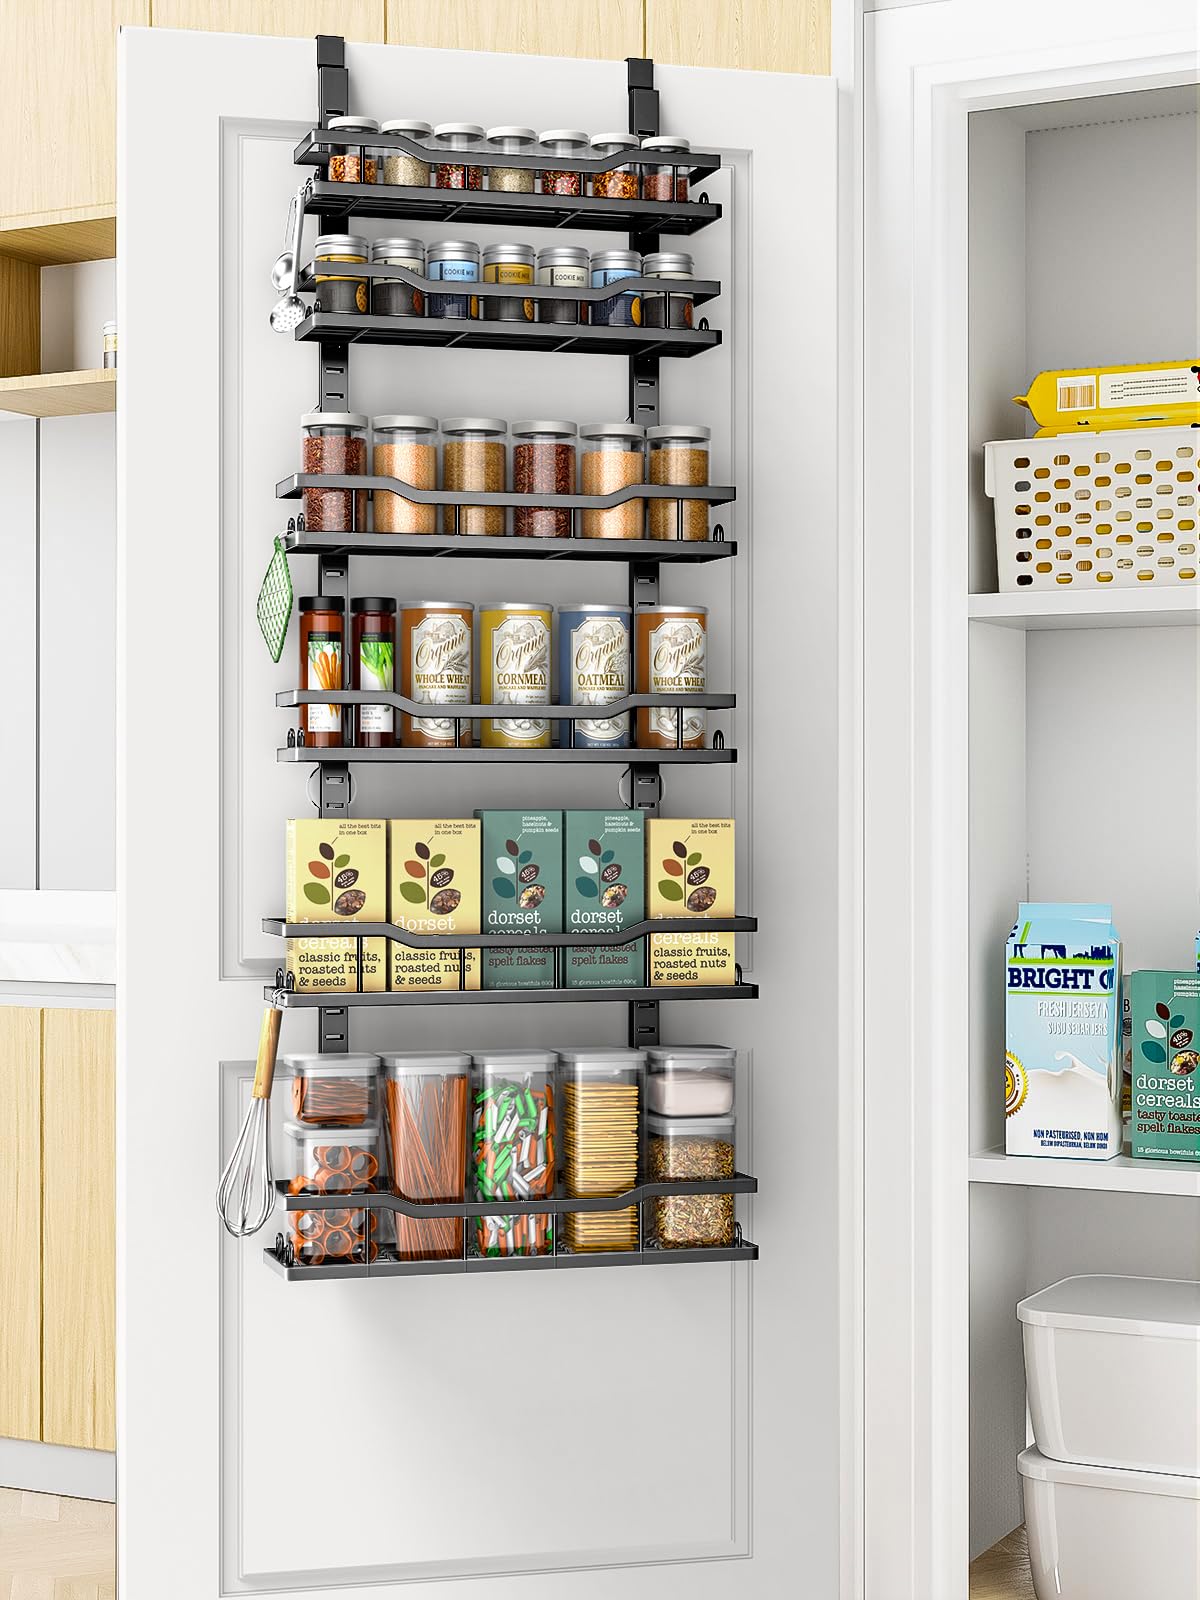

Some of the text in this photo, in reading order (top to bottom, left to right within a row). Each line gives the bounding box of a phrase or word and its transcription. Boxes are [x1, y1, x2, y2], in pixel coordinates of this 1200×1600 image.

[444, 268, 465, 276] COOKIE
[415, 628, 466, 673] Organic
[496, 630, 545, 672] Organic
[576, 631, 624, 672] Organic
[654, 632, 702, 673] Organic
[415, 674, 470, 684] WHOLE WHEAT
[497, 673, 547, 685] CORNMEAL
[578, 673, 624, 686] OATMEAL
[653, 676, 682, 687] WHOLE
[488, 910, 541, 925] dorset
[571, 909, 624, 924] dorset
[394, 916, 456, 931] dorset
[653, 933, 719, 945] cereals
[600, 943, 637, 952] toasted
[653, 947, 731, 958] classic fruits,
[298, 952, 340, 962] classic
[395, 951, 436, 961] classic
[489, 956, 546, 967] spelt flakes
[572, 955, 628, 967] spelt flakes
[298, 964, 345, 974] roasted
[395, 963, 472, 973] roasted nus
[653, 959, 727, 969] roasted nuts
[298, 976, 347, 986] & seeds
[395, 975, 442, 985] & seeds
[653, 971, 698, 981] & seeds
[1008, 967, 1094, 990] BRIGHT
[1038, 1000, 1066, 1018] FRESH
[1069, 1001, 1102, 1019] JERSEY
[1048, 1022, 1066, 1035] SUSU
[1136, 1074, 1195, 1092] dorset
[1136, 1093, 1200, 1109] cereals
[1137, 1109, 1167, 1122] tasty
[1137, 1122, 1200, 1135] spelt flakes
[1033, 1129, 1044, 1138] NON
[1083, 1131, 1095, 1141] NON
